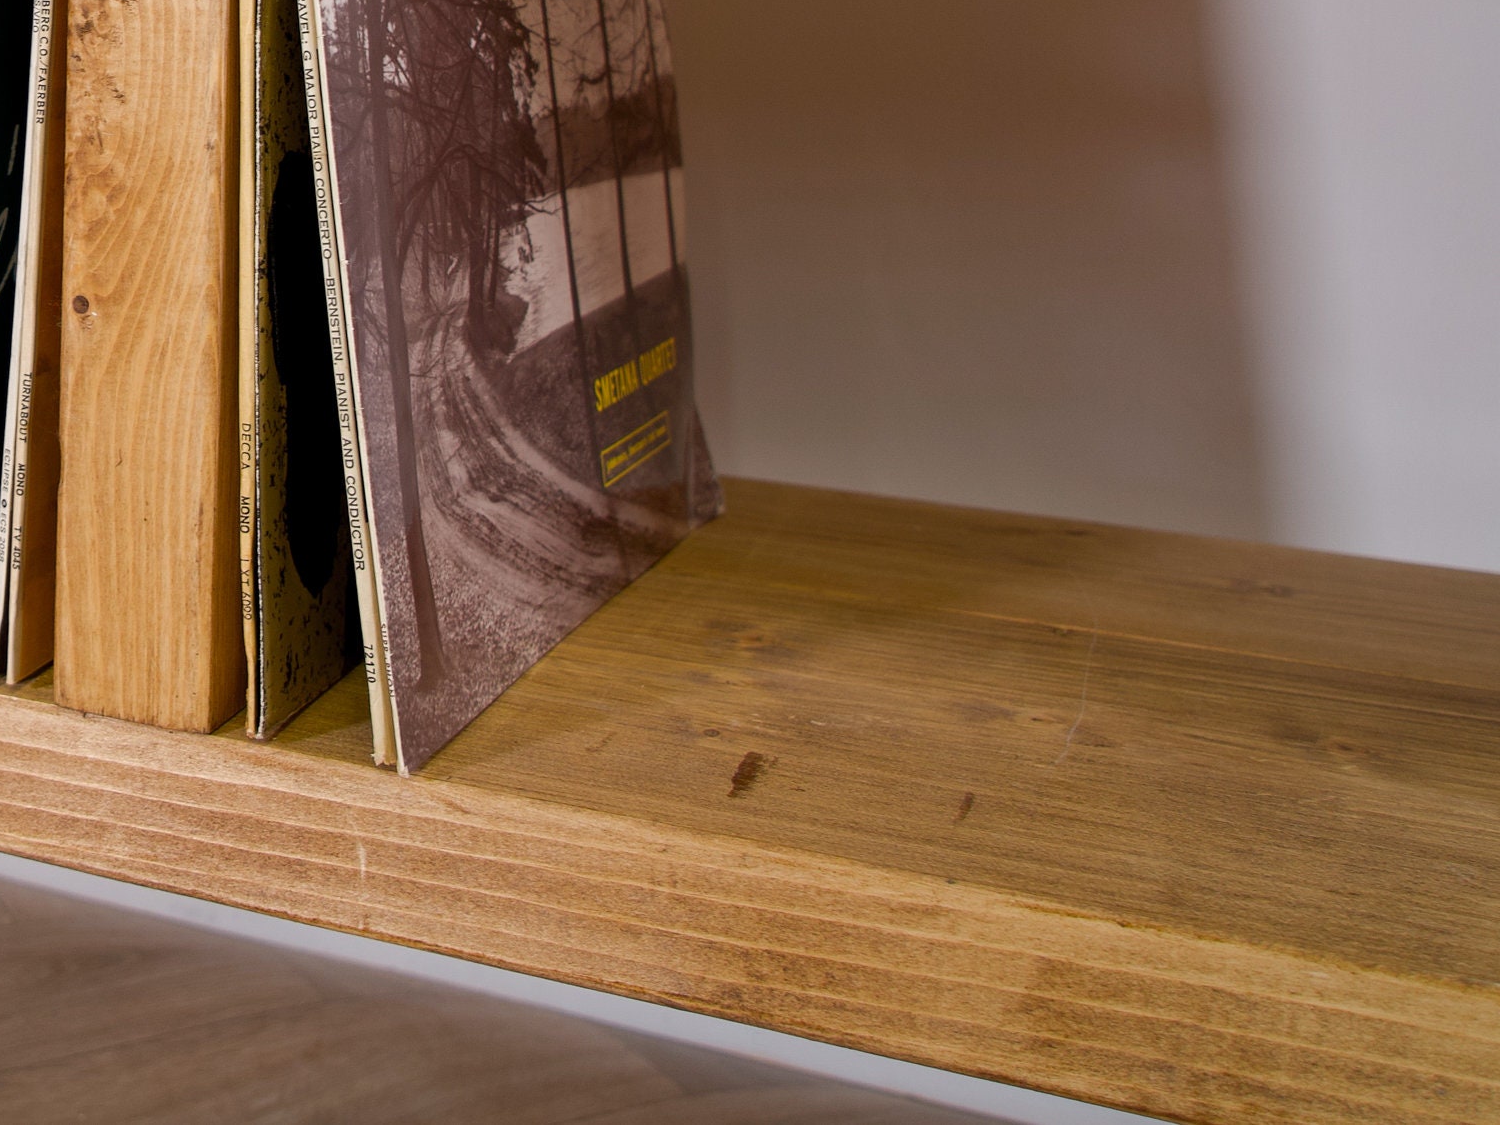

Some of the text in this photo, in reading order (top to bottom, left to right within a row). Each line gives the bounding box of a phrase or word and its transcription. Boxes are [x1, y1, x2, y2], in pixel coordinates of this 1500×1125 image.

[303, 50, 312, 62] G
[304, 68, 319, 121] MAJOR
[335, 373, 351, 432] PIANIST
[594, 359, 639, 413] SMETANA
[241, 423, 252, 470] DECCA
[342, 438, 355, 470] AND
[2, 448, 12, 492] ECLIPSE
[11, 372, 32, 570] TURNABOUT MONO TV 4045
[0, 512, 8, 528] ECS
[240, 495, 251, 534] MONO
[346, 475, 366, 571] CONDUCTOR
[364, 644, 377, 684] 72170
